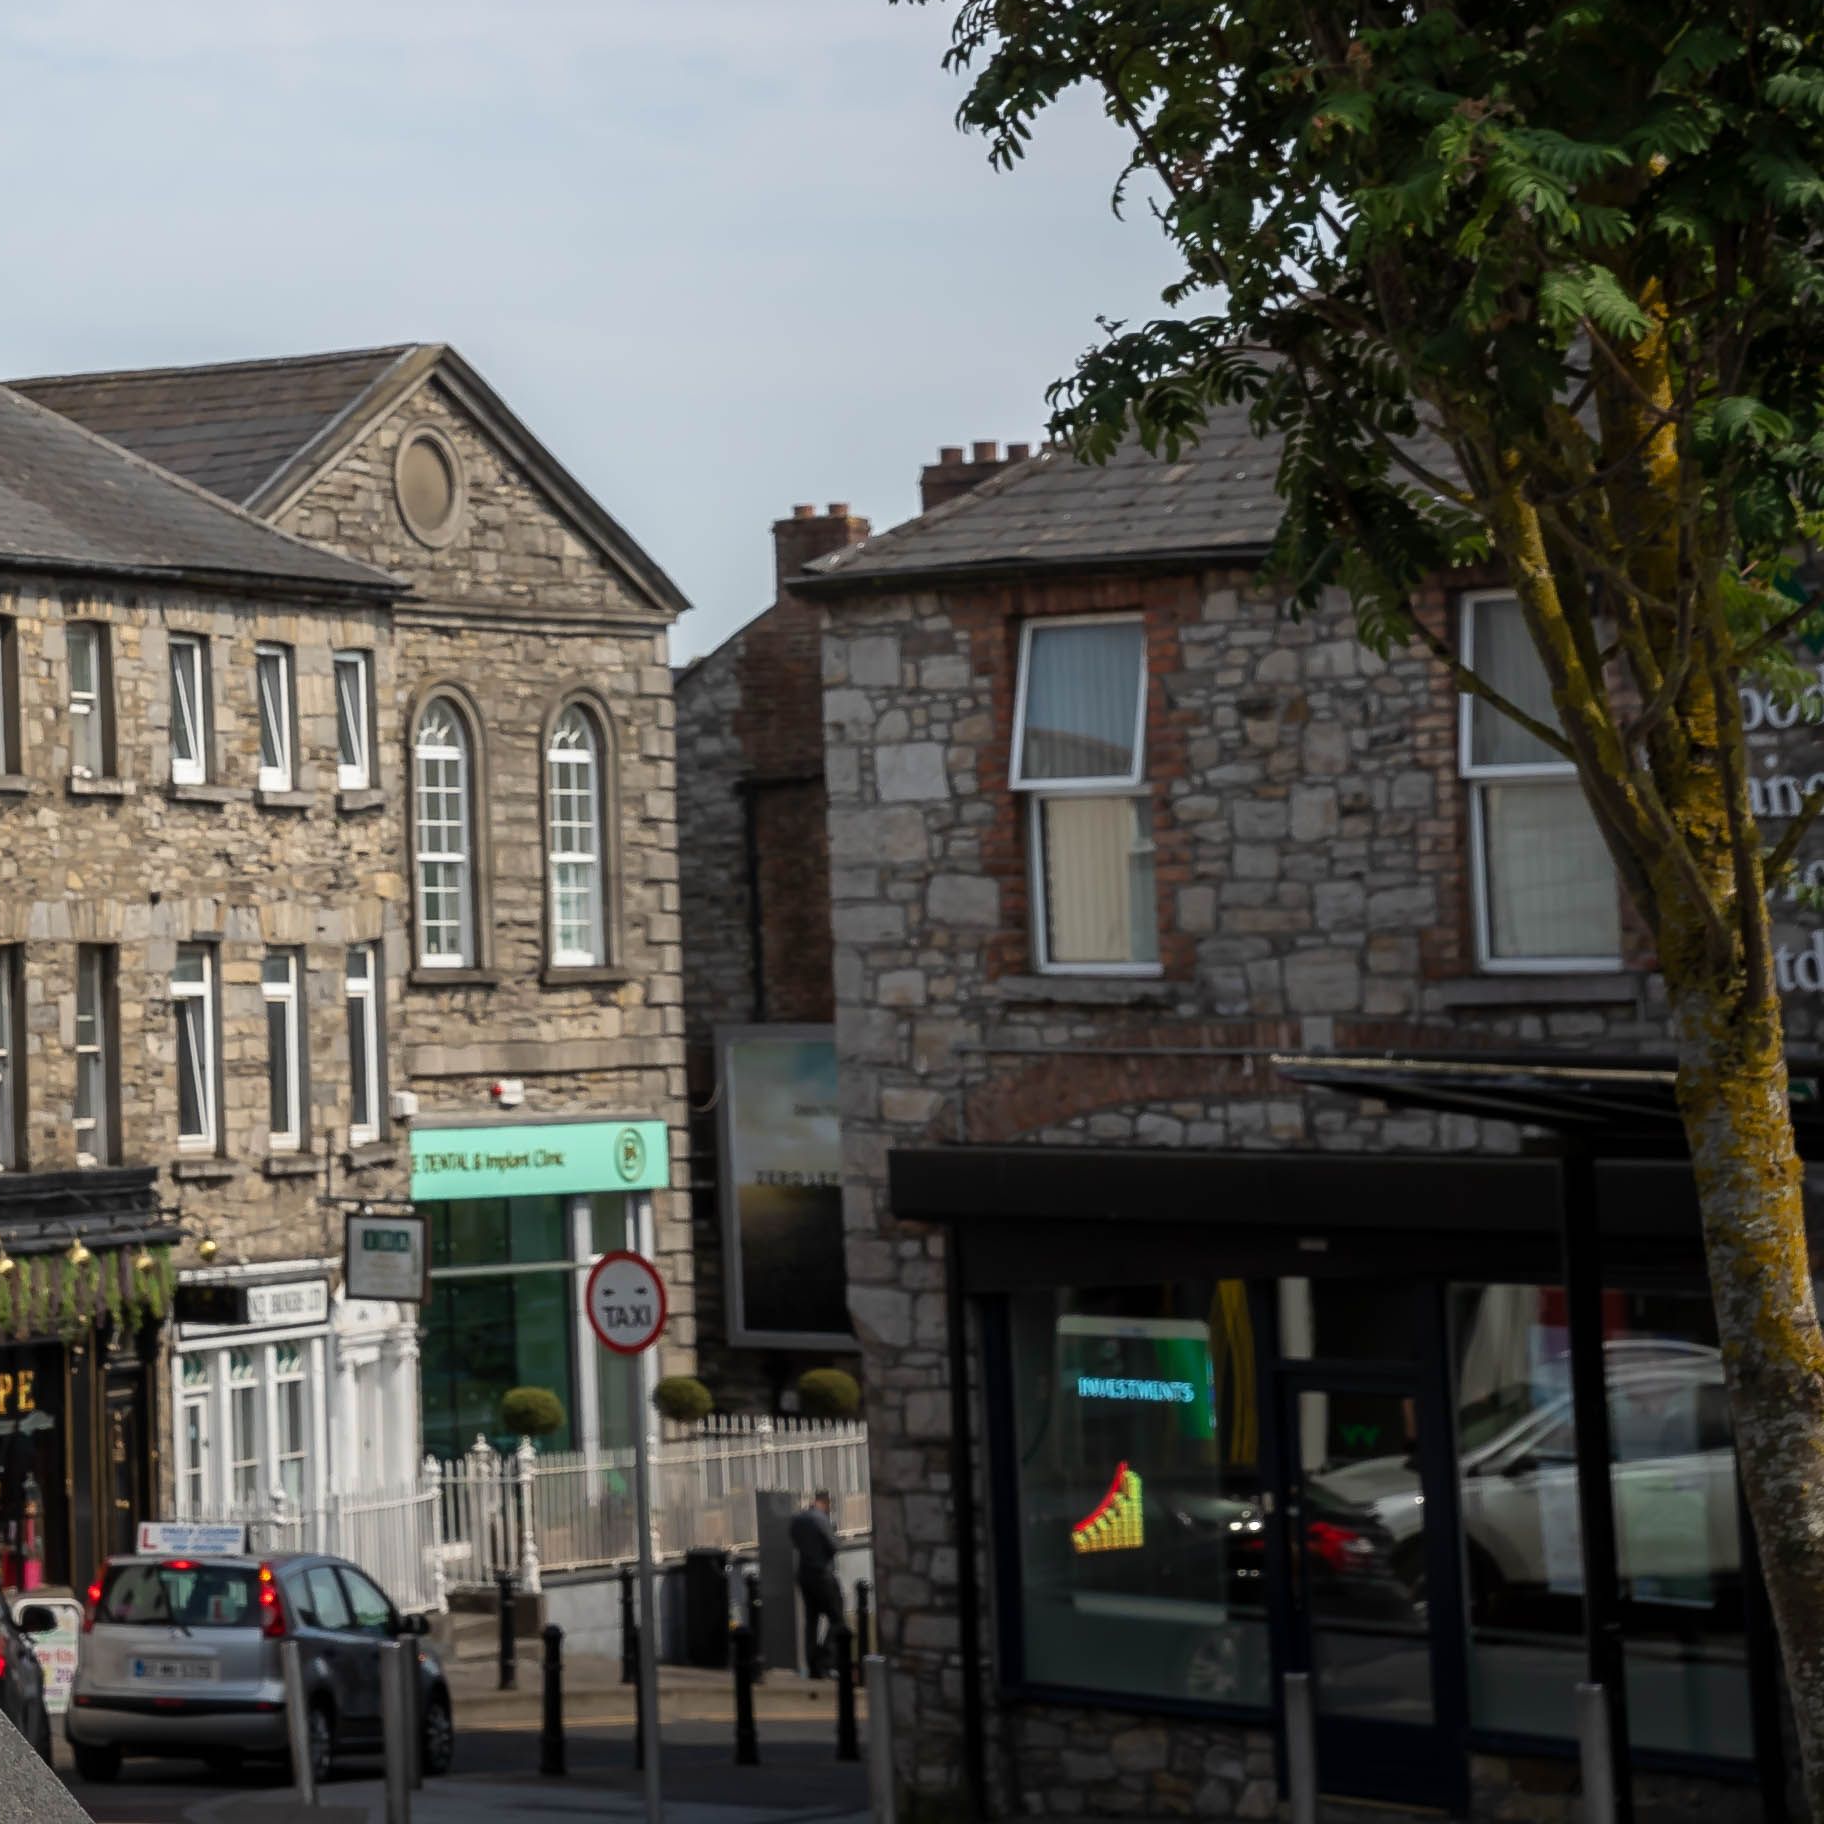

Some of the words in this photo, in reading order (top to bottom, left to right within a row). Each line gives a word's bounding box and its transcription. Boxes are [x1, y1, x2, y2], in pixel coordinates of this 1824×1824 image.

[424, 1153, 469, 1173] DENTAL
[602, 1305, 651, 1328] TAXI
[1078, 1376, 1195, 1403] INVESTMENTS
